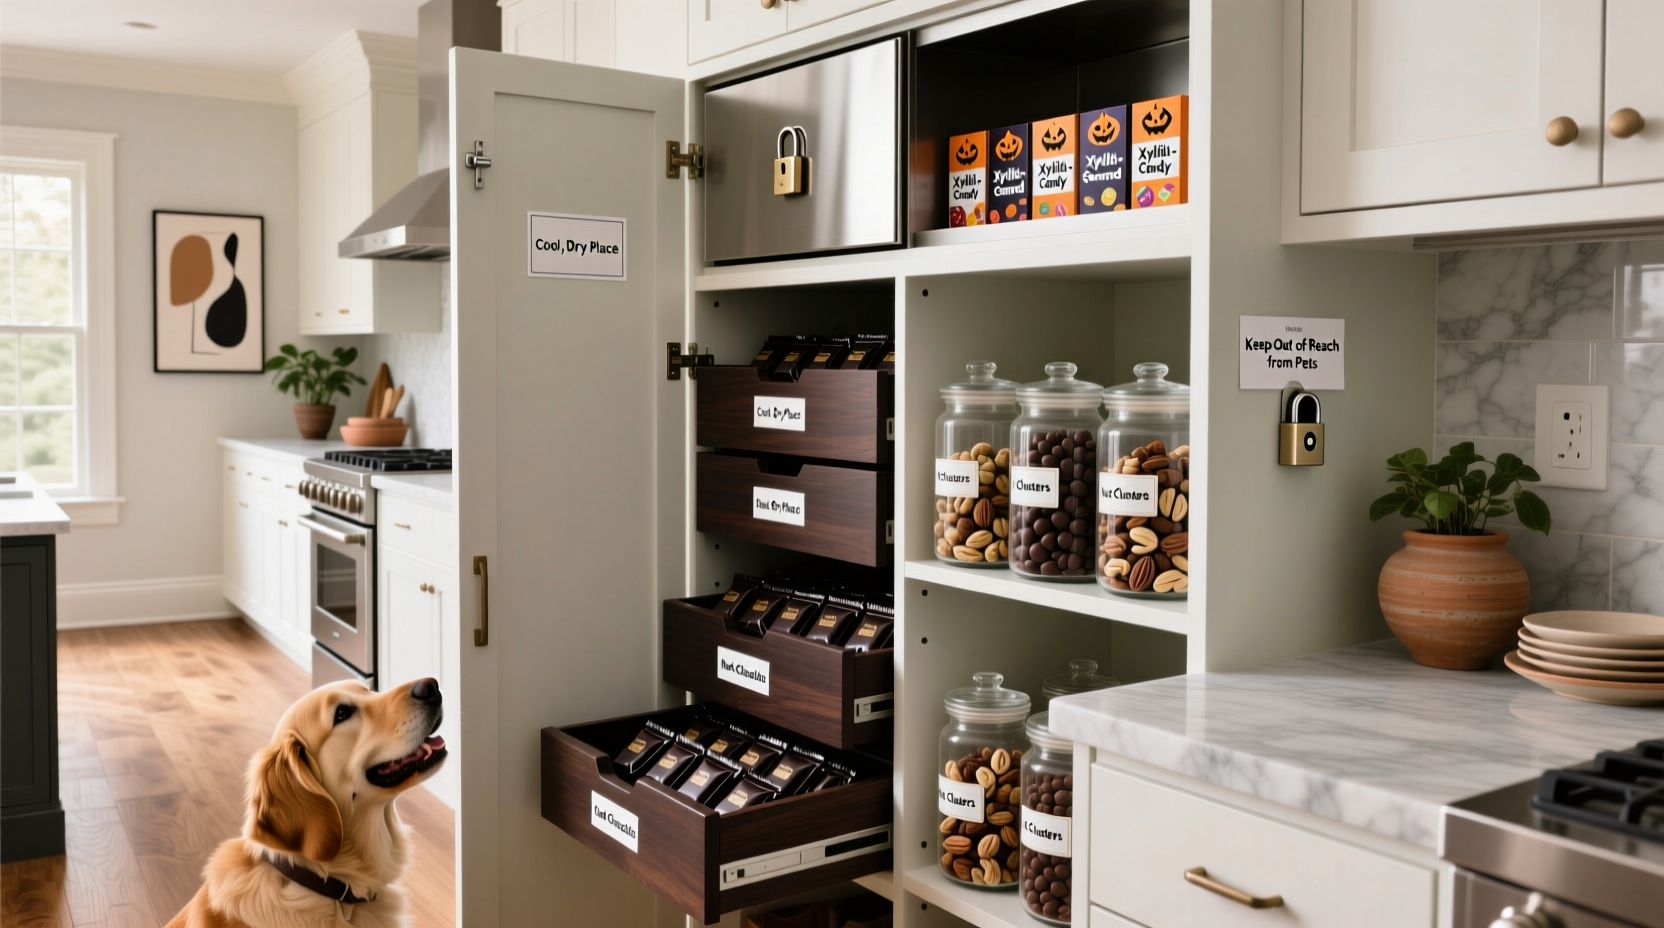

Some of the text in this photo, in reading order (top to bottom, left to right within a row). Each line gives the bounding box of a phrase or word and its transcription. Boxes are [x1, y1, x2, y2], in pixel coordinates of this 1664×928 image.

[566, 239, 587, 256] Dry
[590, 240, 619, 254] Place
[1245, 337, 1340, 354] Keep Out of Reach
[1267, 355, 1318, 369] from Pets
